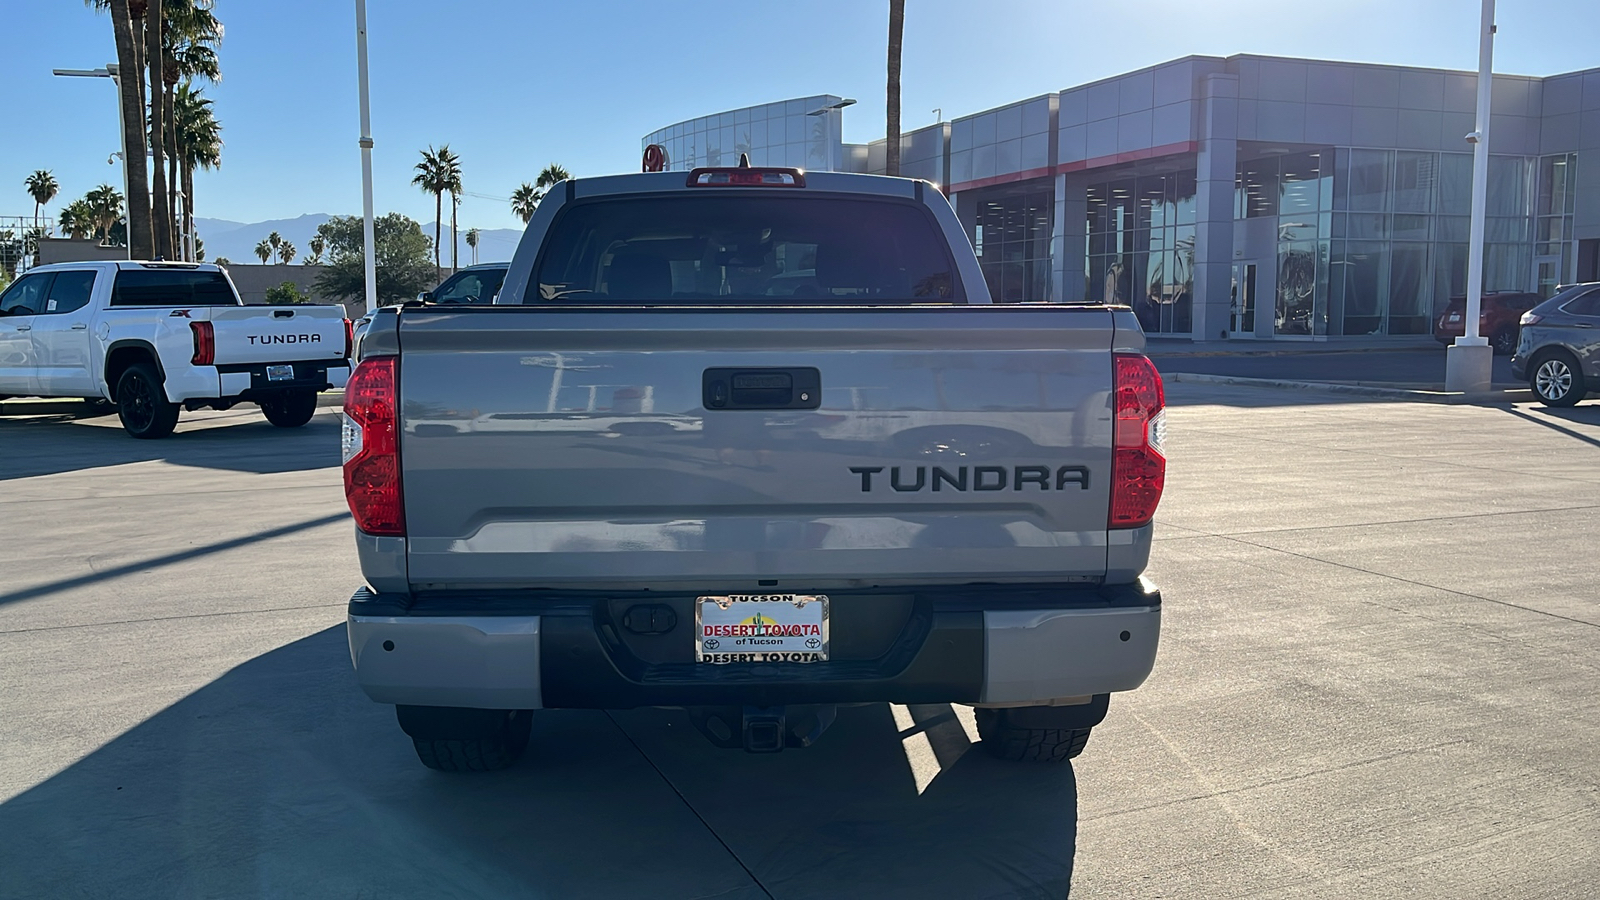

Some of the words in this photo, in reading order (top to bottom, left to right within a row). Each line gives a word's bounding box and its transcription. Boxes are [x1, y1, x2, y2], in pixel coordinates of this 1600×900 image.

[247, 333, 321, 345] TUNDRA
[848, 465, 1091, 492] TUNDRA
[704, 624, 758, 637] DESERT
[764, 624, 821, 636] TOYOTA
[748, 637, 784, 645] Tucson
[703, 653, 756, 663] DESERT
[762, 652, 820, 662] TOYOTA
